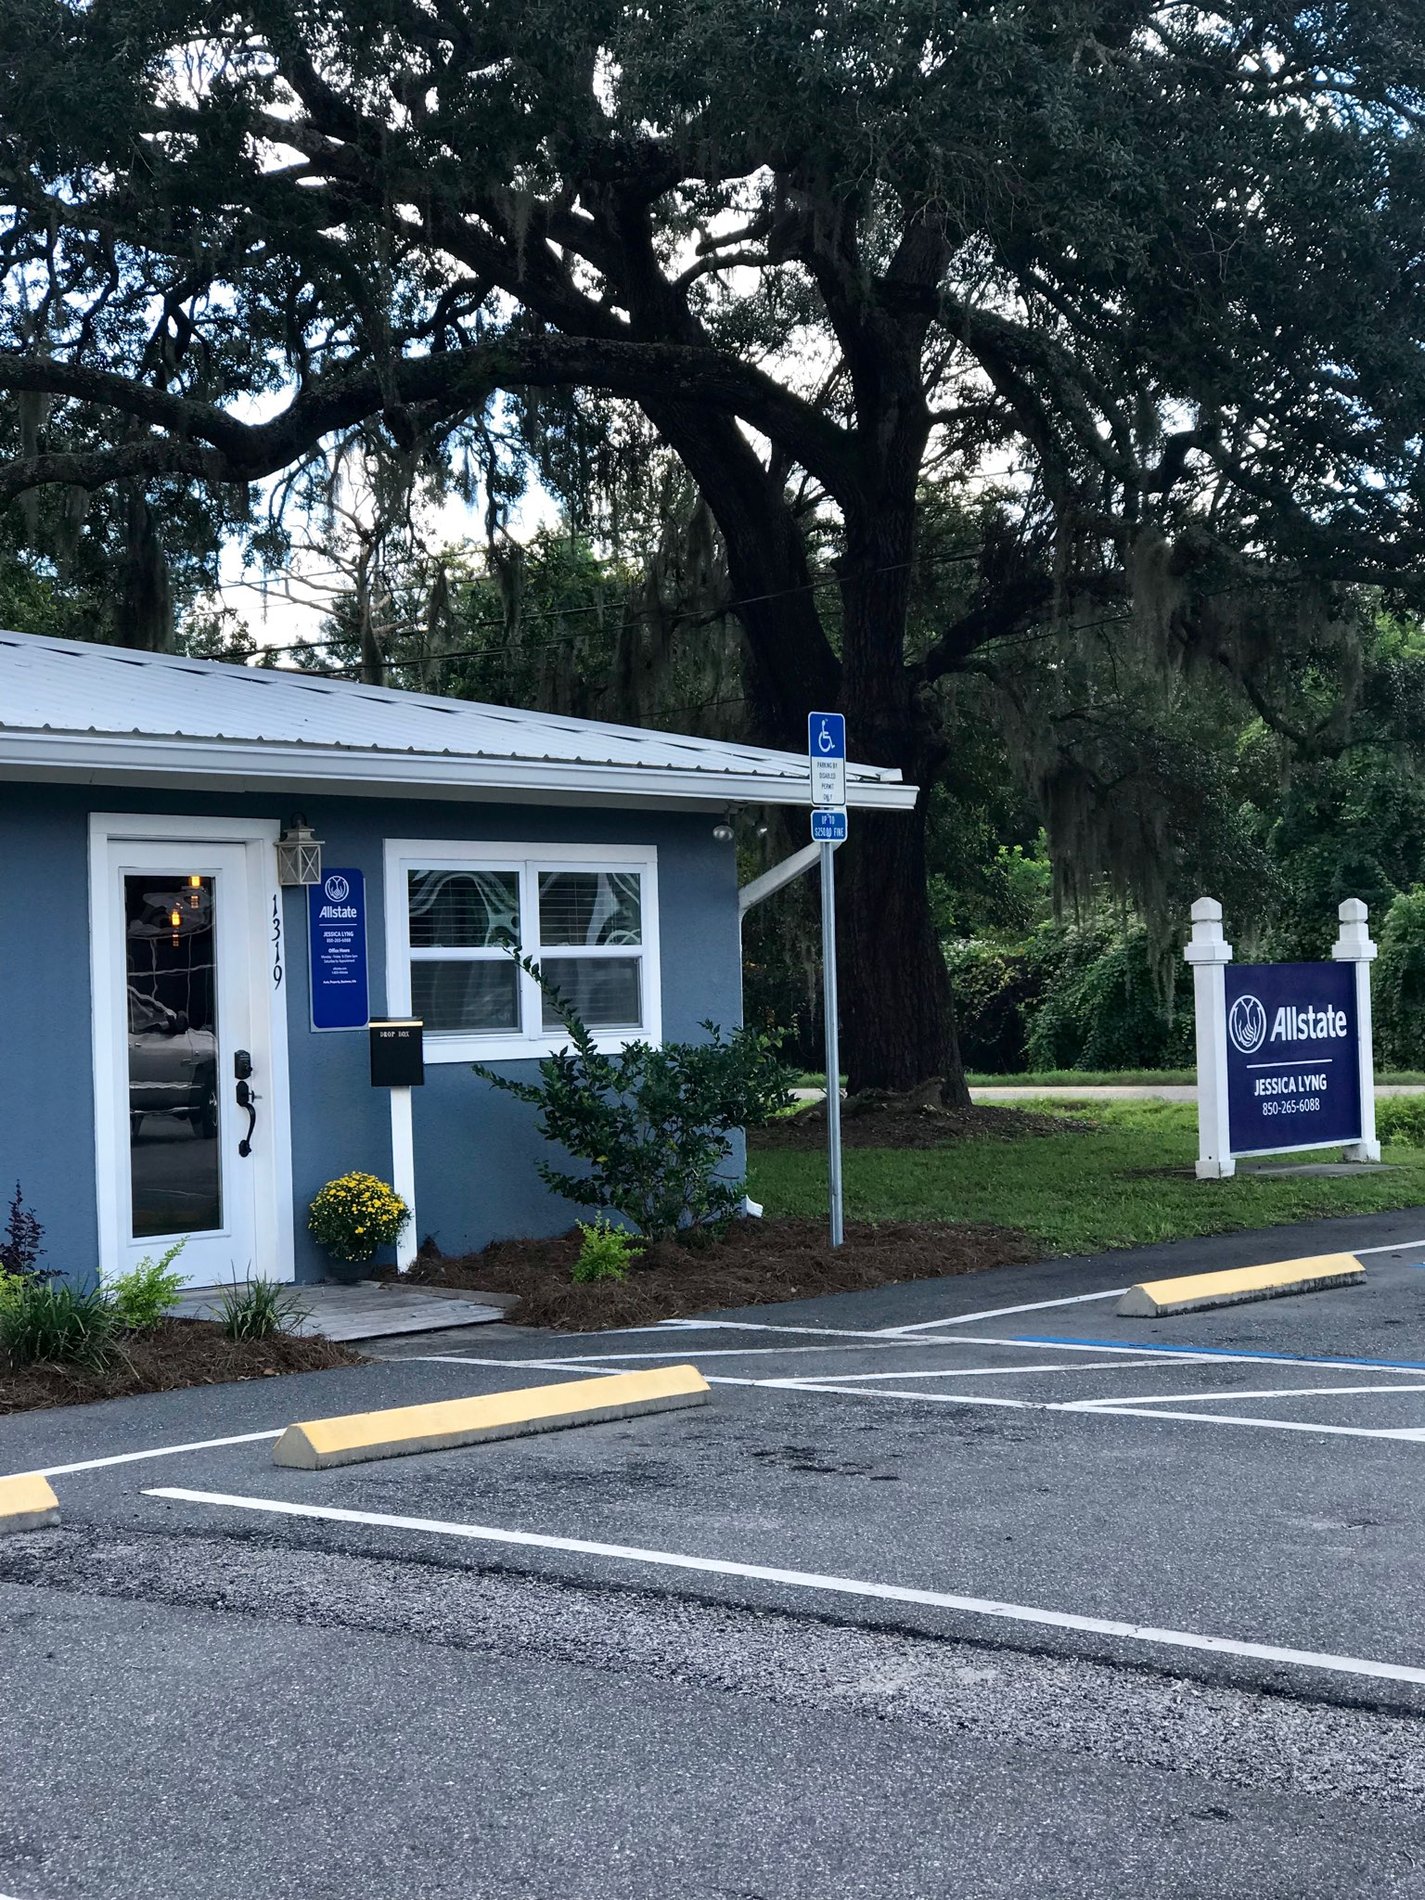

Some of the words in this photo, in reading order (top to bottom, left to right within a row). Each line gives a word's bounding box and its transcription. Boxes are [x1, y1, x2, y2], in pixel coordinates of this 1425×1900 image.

[834, 827, 844, 837] FINE
[318, 906, 358, 918] Allstate
[272, 894, 282, 990] 1319
[1270, 1004, 1347, 1042] Allstate
[1254, 1076, 1296, 1096] JESSICA
[1299, 1073, 1328, 1092] LYNG
[1262, 1098, 1320, 1116] 850-265-6088
